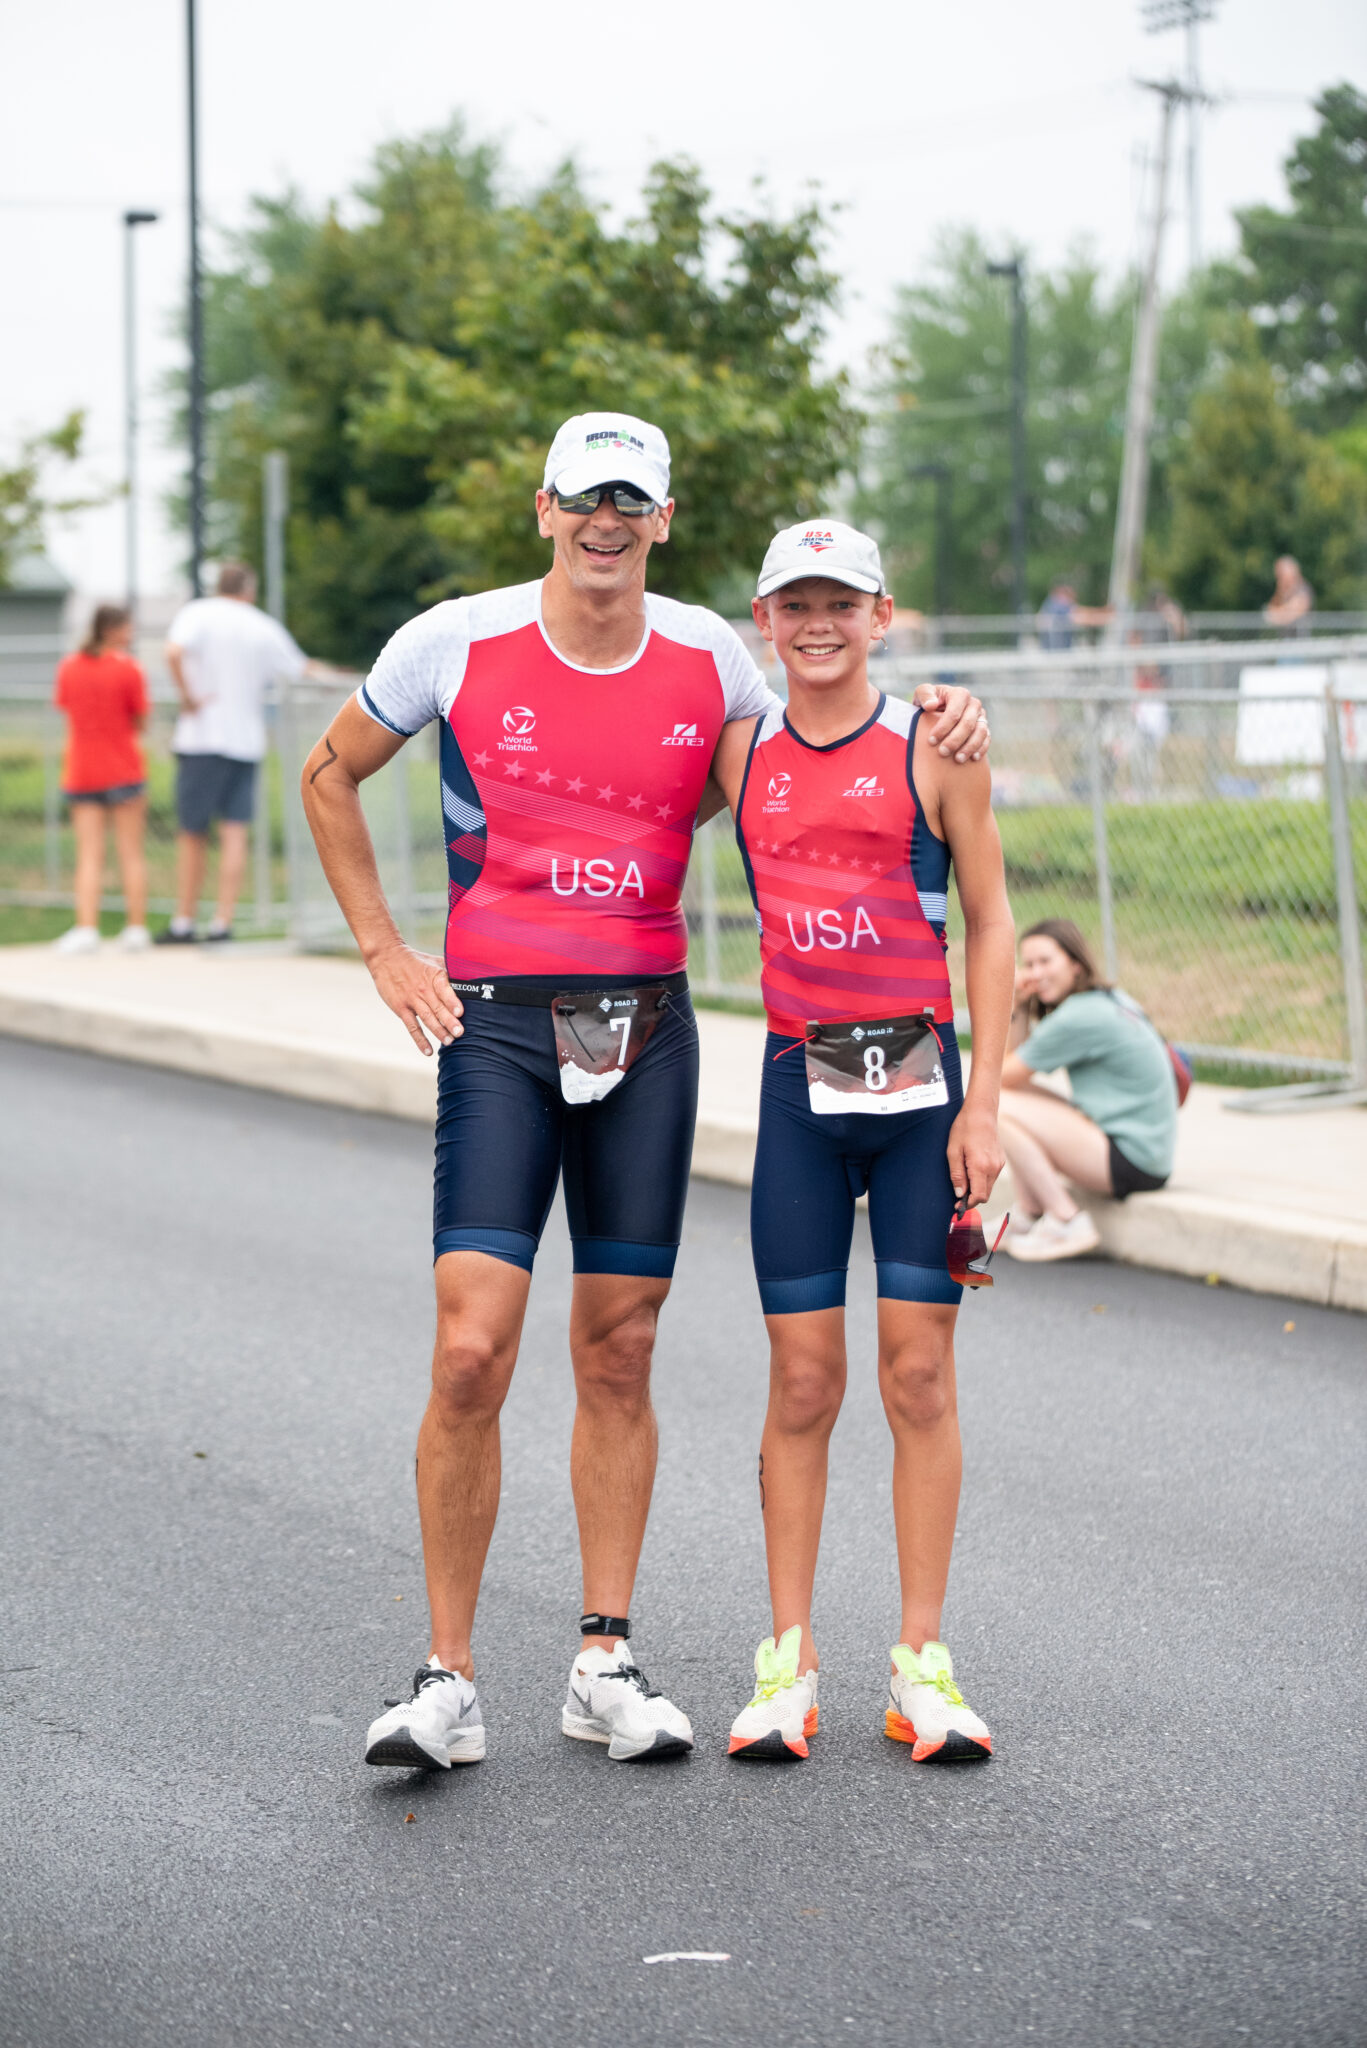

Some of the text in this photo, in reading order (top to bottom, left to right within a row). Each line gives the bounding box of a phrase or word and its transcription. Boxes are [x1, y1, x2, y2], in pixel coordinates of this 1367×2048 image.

[585, 439, 609, 452] 70.3
[586, 429, 645, 450] IRONMAN
[503, 735, 532, 744] World
[661, 736, 705, 747] ZONE3
[496, 742, 538, 752] Triathlon
[841, 787, 885, 797] ZONE3
[762, 806, 790, 814] Triathlon
[551, 858, 645, 899] USA
[786, 906, 881, 953] USA
[867, 1028, 886, 1037] ROAD
[609, 1017, 631, 1066] 7
[863, 1045, 887, 1091] 8
